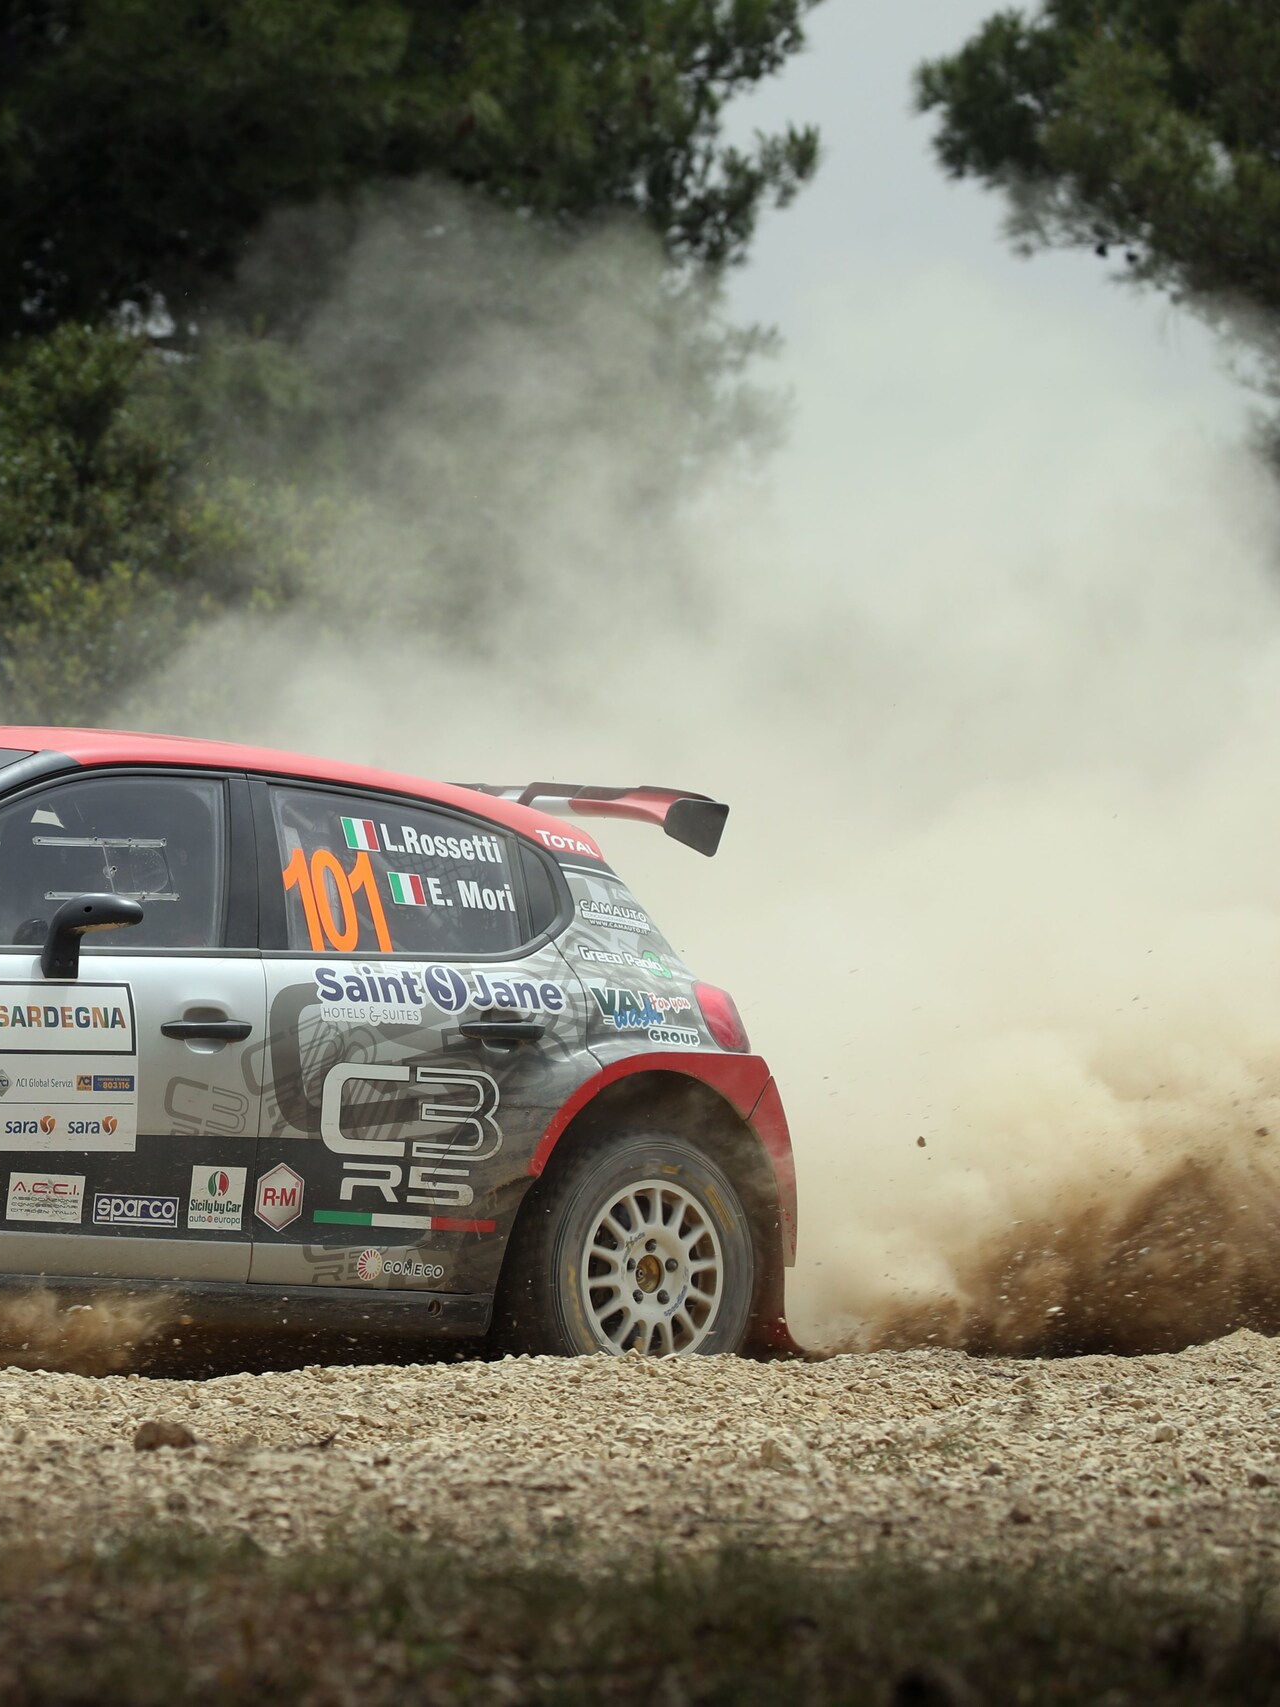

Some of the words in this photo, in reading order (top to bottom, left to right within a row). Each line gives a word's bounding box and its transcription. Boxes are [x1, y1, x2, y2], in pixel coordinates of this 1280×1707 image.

[535, 829, 600, 858] TOTAL
[282, 847, 394, 953] 101
[427, 877, 454, 907] E.
[458, 880, 516, 911] Mori
[579, 946, 624, 964] Greco
[624, 952, 664, 971] Paolo
[315, 963, 423, 1004] Saint
[472, 974, 563, 1010] Jane
[323, 1007, 366, 1019] HOTELS
[369, 1006, 384, 1023] &
[383, 1010, 420, 1021] SUITES
[650, 1029, 699, 1045] GROUP
[16, 1078, 28, 1088] ACI
[29, 1077, 50, 1088] Global
[51, 1078, 74, 1088] Servizi
[321, 1062, 504, 1162] C3
[5, 1121, 38, 1134] sara
[68, 1121, 100, 1134] sara
[339, 1162, 475, 1207] R5
[225, 1200, 242, 1213] Car
[263, 1187, 297, 1207] R-M
[97, 1197, 176, 1223] sparco
[189, 1214, 207, 1224] auto
[213, 1216, 241, 1226] europa
[383, 1261, 444, 1278] COMECO
